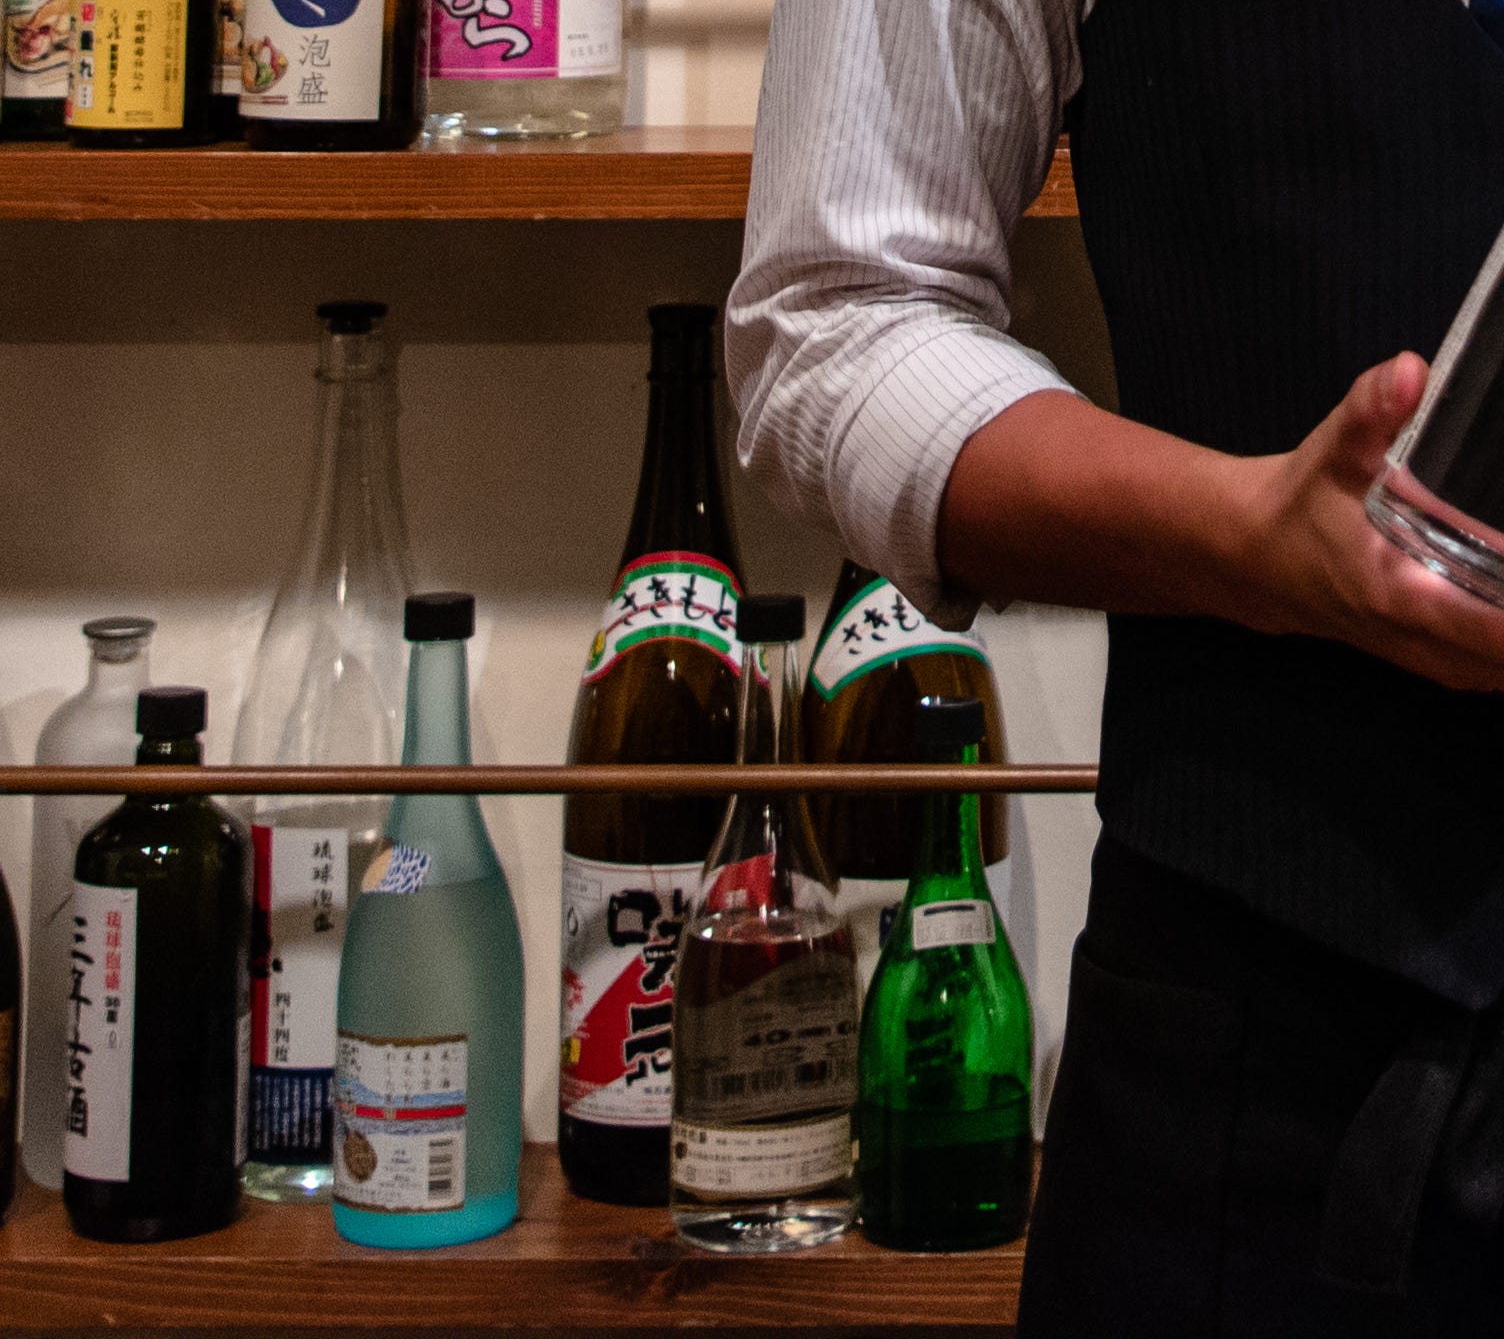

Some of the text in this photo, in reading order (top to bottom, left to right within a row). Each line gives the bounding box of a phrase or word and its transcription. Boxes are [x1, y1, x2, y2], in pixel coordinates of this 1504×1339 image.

[296, 31, 332, 107] 泡盛
[618, 571, 738, 635] さきもと
[310, 839, 336, 934] 琉球泡盛
